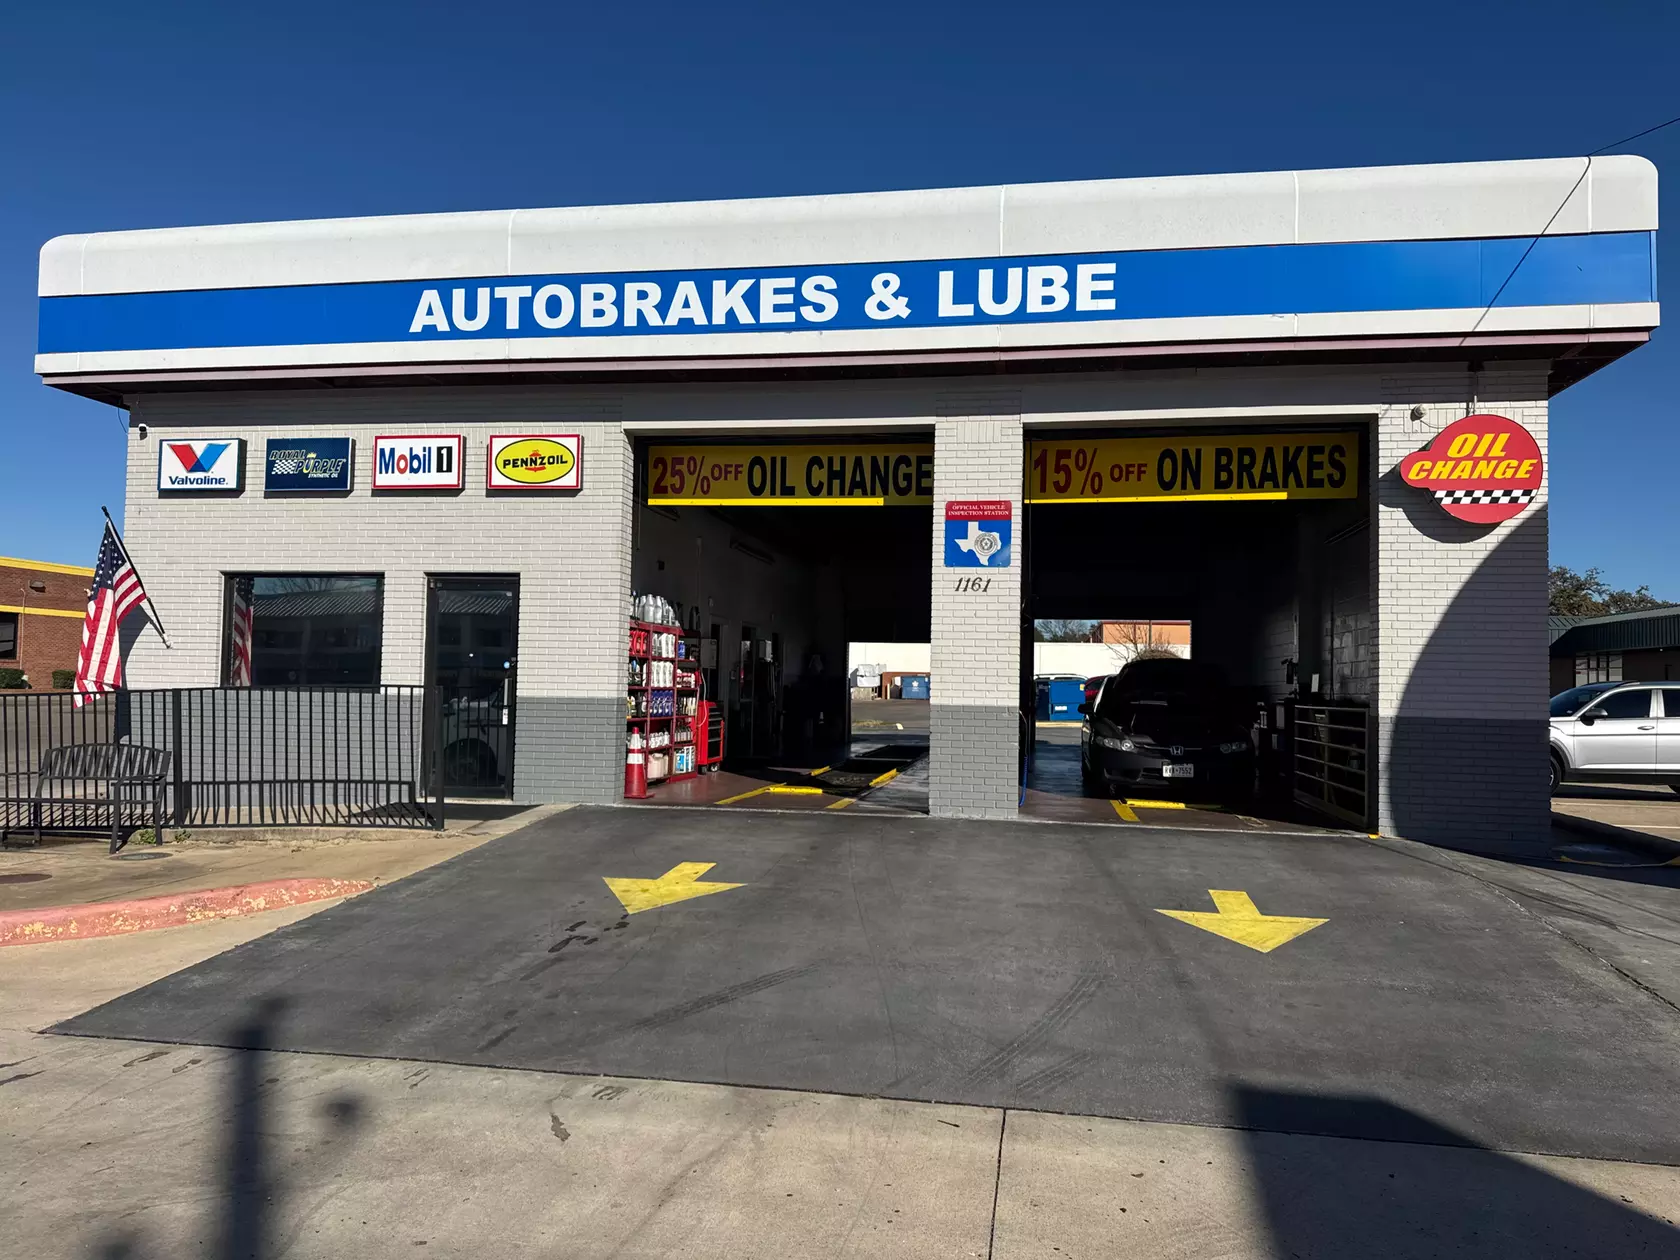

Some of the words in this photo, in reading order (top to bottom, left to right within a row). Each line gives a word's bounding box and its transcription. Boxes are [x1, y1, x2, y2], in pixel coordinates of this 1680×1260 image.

[408, 275, 839, 333] AUTOBRAKES
[864, 272, 912, 321] &
[937, 262, 1117, 318] LUBE
[269, 449, 306, 460] ROYAL
[1447, 433, 1511, 458] OIL
[294, 458, 344, 474] PURPLE
[378, 446, 431, 475] Mobil
[503, 454, 568, 469] PENNZOIL
[1033, 448, 1103, 495] 15%
[1110, 463, 1148, 482] OFF
[1157, 448, 1203, 491] ON
[1214, 444, 1347, 490] BRAKES
[1407, 458, 1538, 480] CHANGE
[652, 455, 711, 496] 25%
[711, 463, 744, 481] OFF
[747, 455, 796, 496] OIL
[805, 454, 933, 497] CHANGE
[954, 576, 992, 592] 1161
